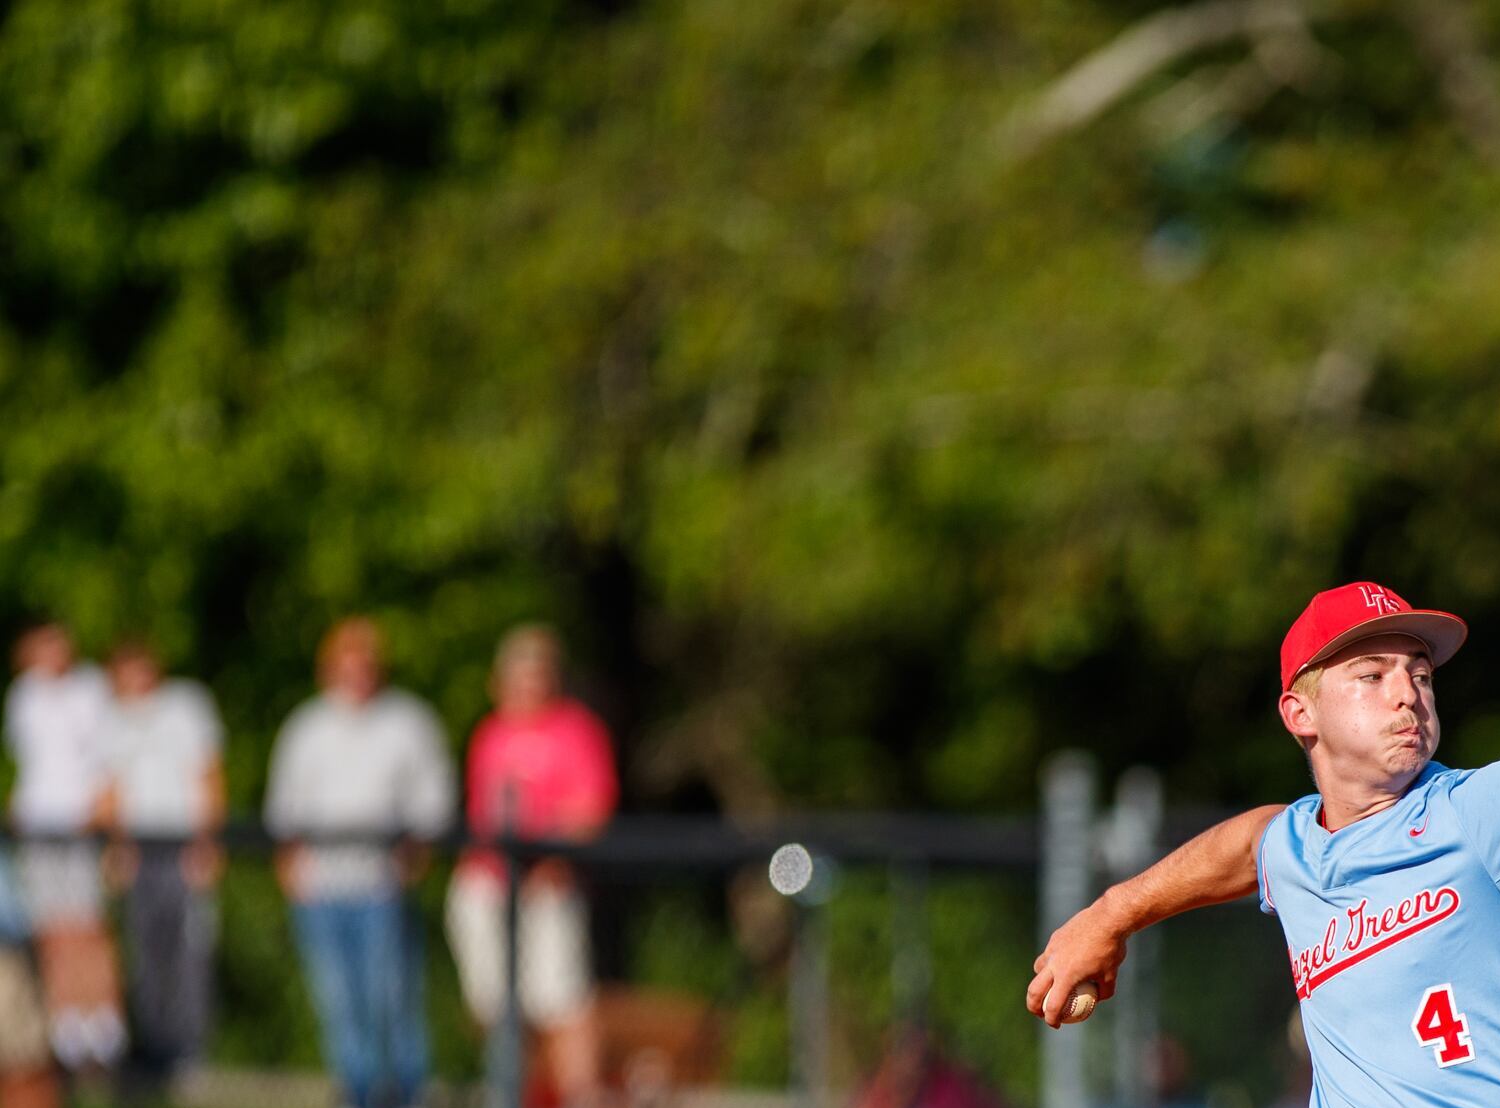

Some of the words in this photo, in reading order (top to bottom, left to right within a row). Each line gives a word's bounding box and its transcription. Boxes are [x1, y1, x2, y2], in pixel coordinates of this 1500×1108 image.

[1288, 917, 1337, 999] azel
[1341, 887, 1461, 953] Green
[1411, 982, 1476, 1069] 4
